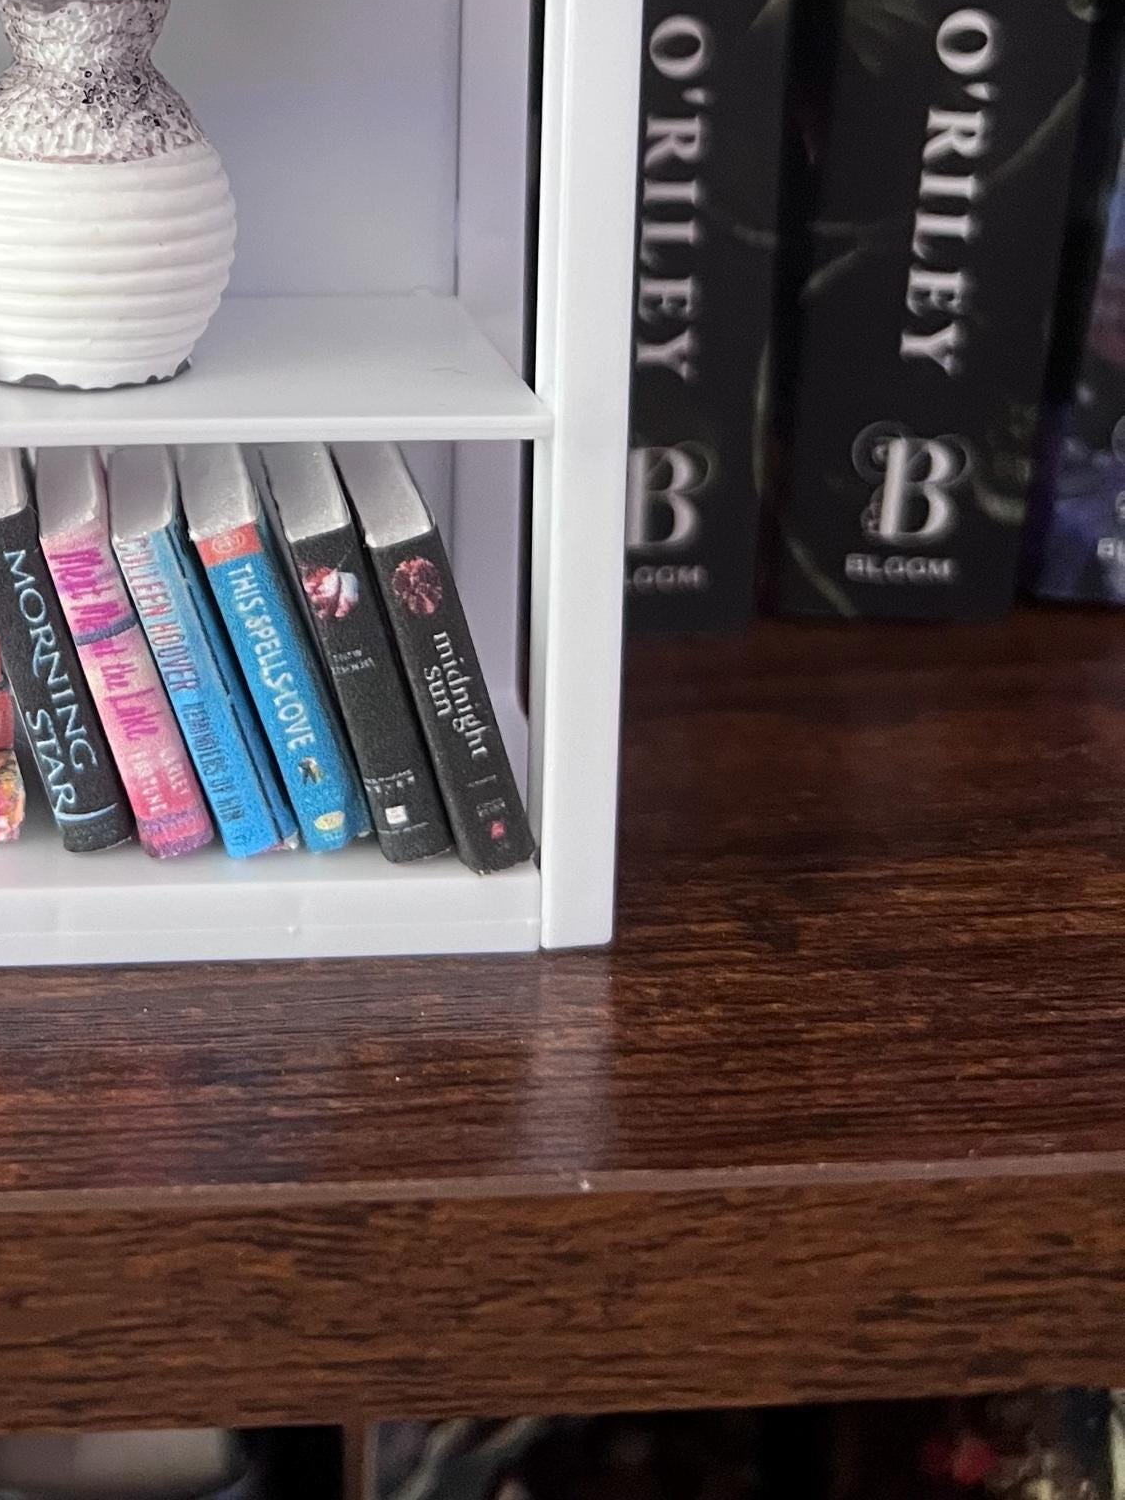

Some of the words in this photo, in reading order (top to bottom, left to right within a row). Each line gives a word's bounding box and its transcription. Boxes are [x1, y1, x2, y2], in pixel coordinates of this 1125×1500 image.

[635, 13, 713, 384] O'RILEY
[898, 7, 1000, 377] O'RILEY
[48, 546, 115, 600] Meet
[118, 536, 174, 618] COLLEEN
[147, 622, 201, 692] HOOVER
[227, 562, 265, 614] THIS
[3, 548, 99, 773] MORNING
[100, 662, 139, 692] the
[243, 603, 291, 688] SPELLS
[105, 686, 163, 742] Lake
[274, 686, 317, 753] LOVE
[423, 666, 450, 718] sun
[433, 630, 489, 761] midnight
[25, 707, 105, 821] STAR
